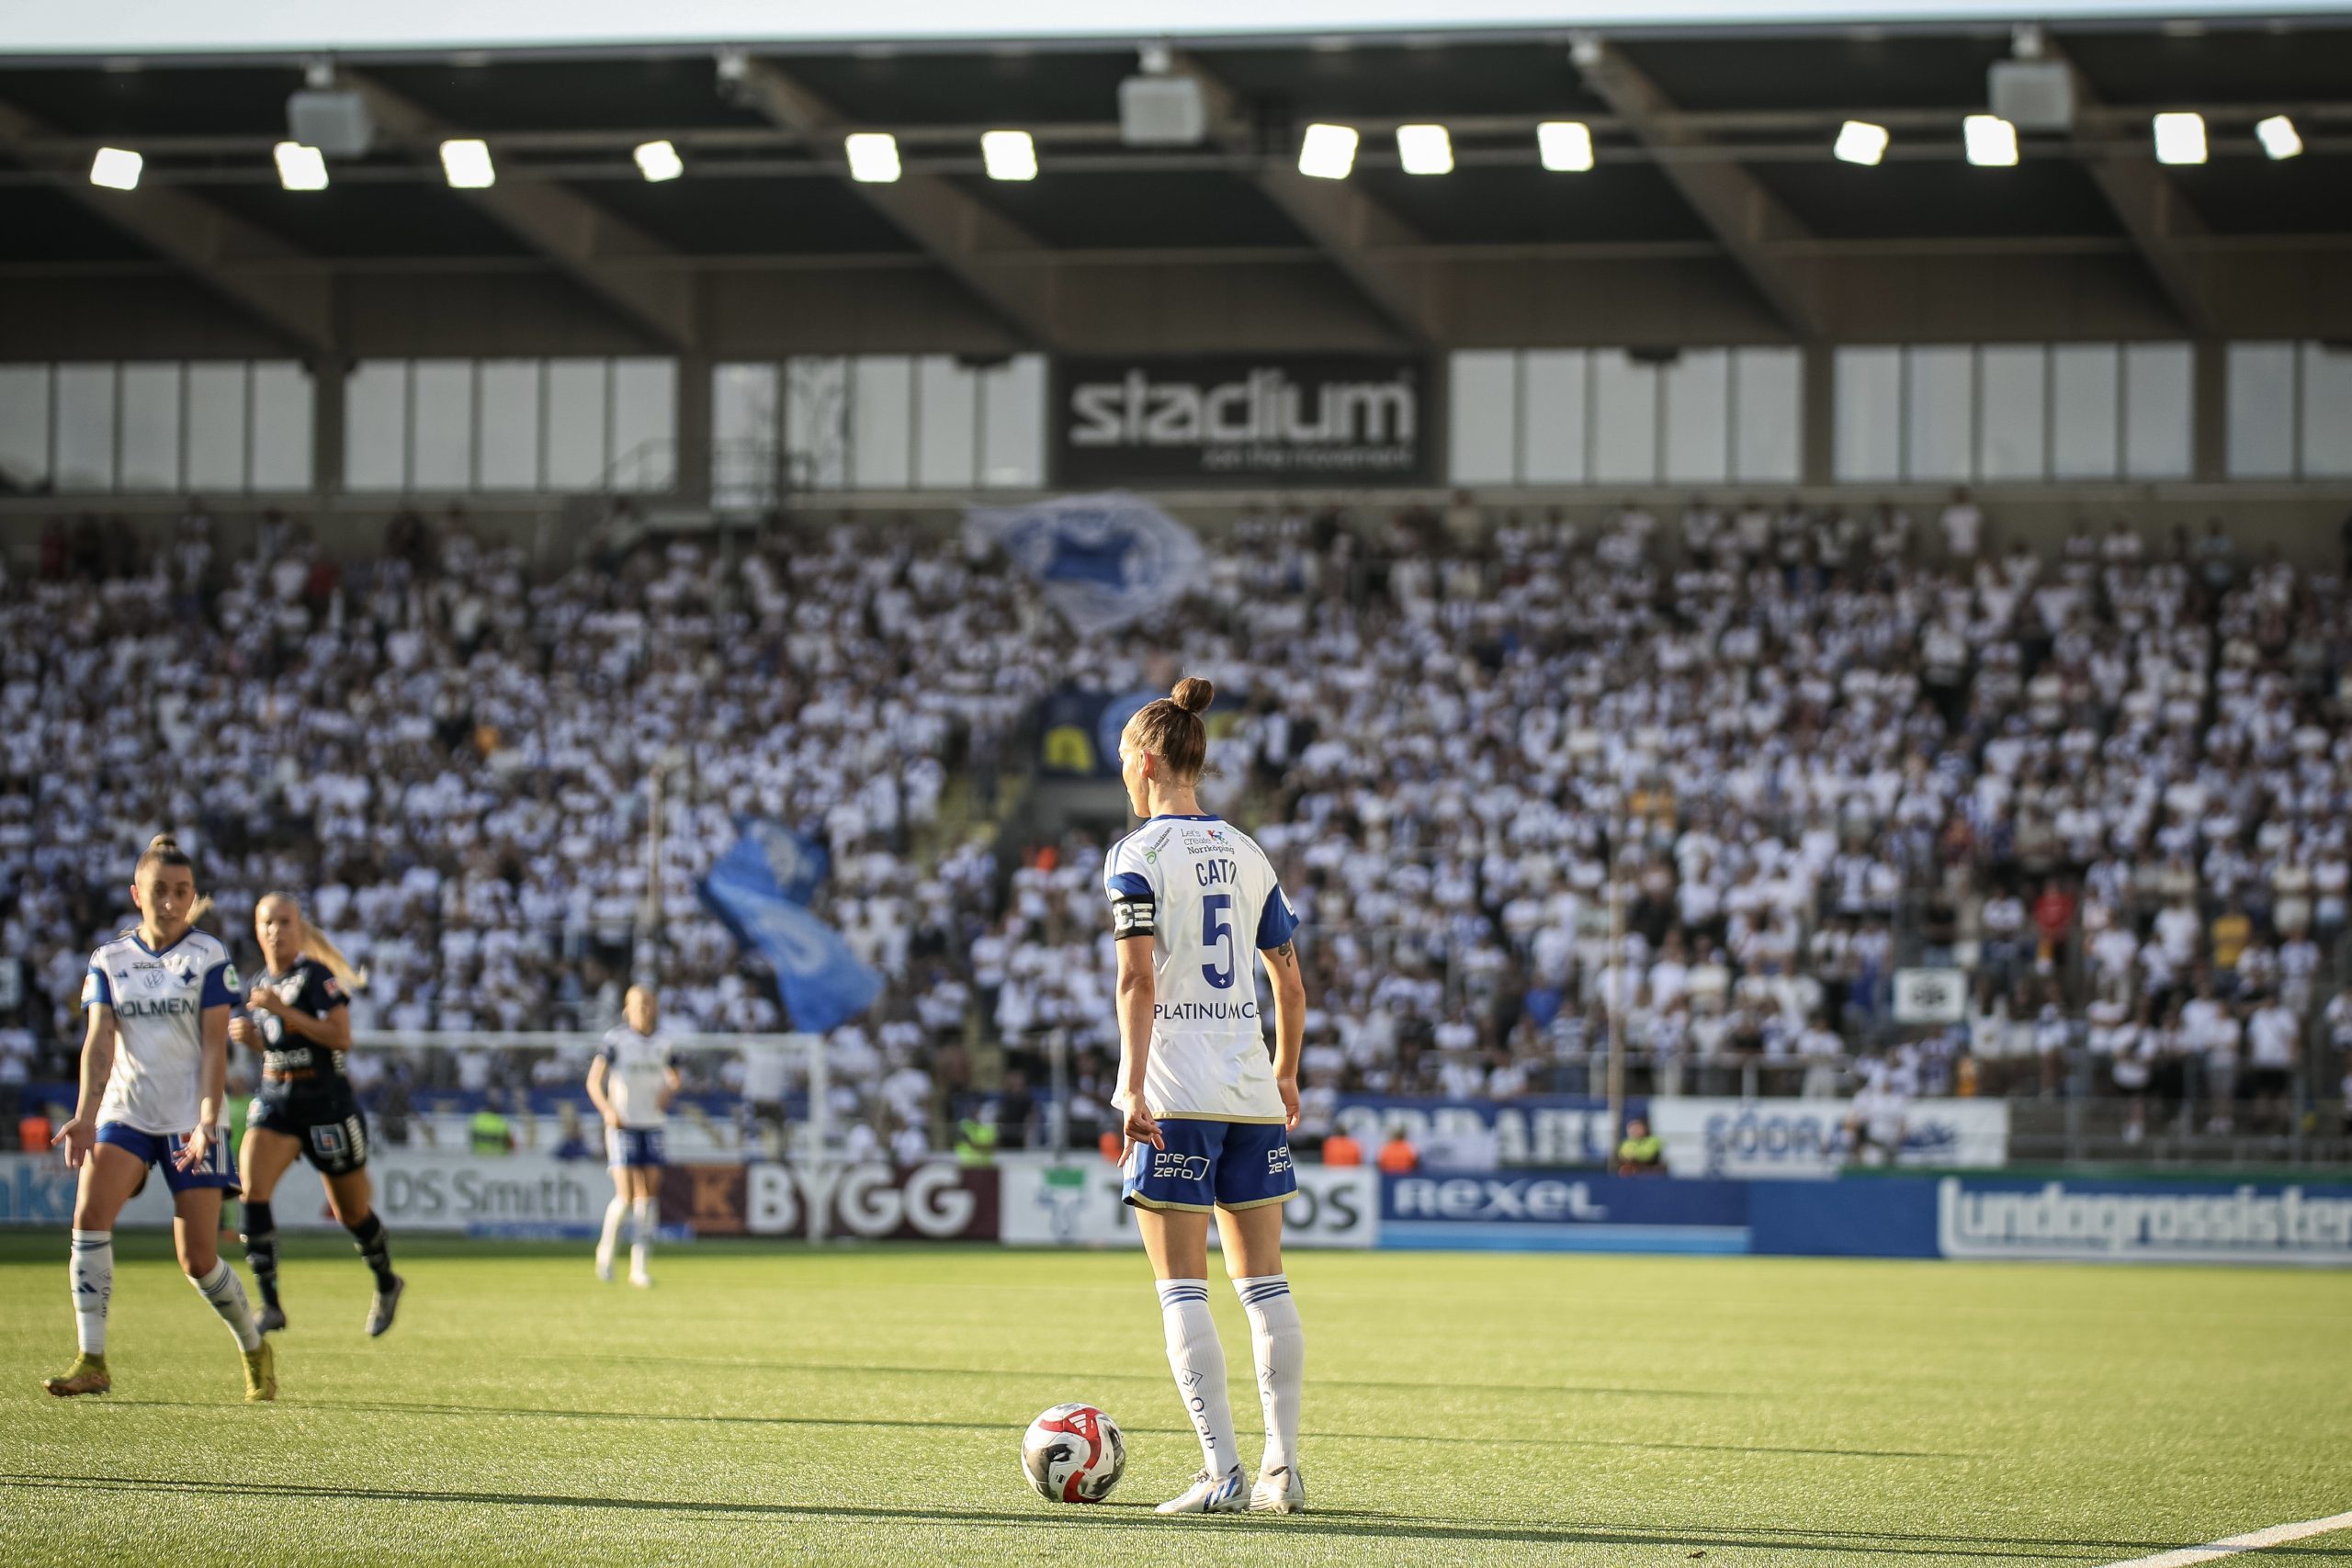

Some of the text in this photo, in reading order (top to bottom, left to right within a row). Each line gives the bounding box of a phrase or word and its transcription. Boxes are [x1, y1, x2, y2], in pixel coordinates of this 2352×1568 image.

[1069, 369, 1418, 446] stadium
[1195, 859, 1237, 886] CATO
[1202, 894, 1234, 988] 5
[1153, 1167, 1193, 1179] zero
[1155, 1153, 1185, 1166] pre
[385, 1168, 589, 1215] DS Smith
[746, 1162, 977, 1237] BYGG
[1190, 1395, 1217, 1450] Ocab
